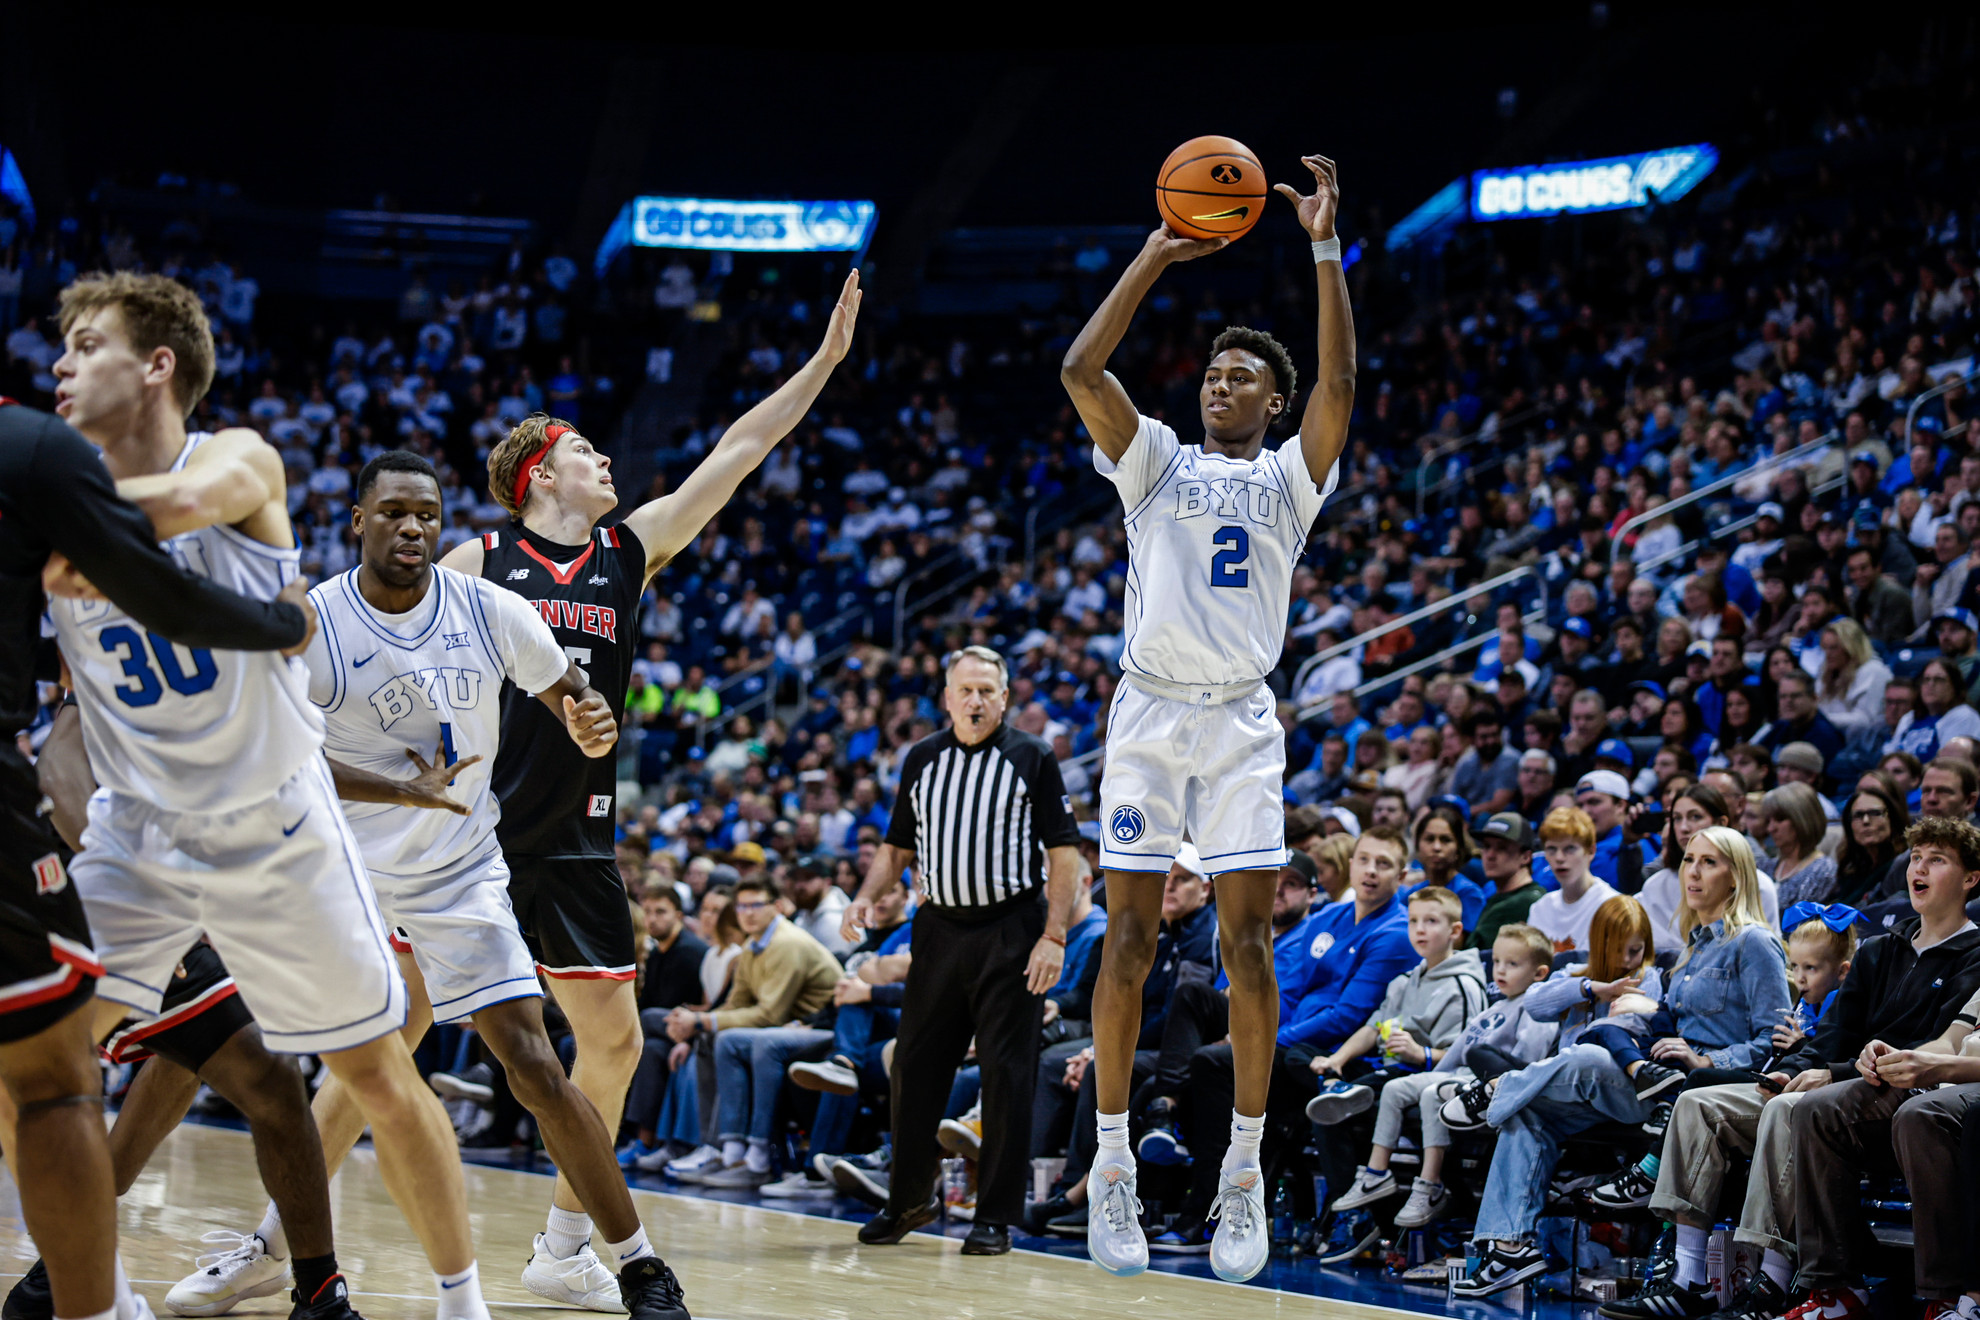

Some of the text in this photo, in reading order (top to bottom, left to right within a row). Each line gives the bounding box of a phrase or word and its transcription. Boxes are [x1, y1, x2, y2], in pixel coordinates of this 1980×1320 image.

[1479, 163, 1634, 214] GO COUGS
[646, 207, 684, 236] GO
[1174, 478, 1282, 528] BYU
[1210, 525, 1250, 588] 2
[530, 599, 617, 645] NVER
[99, 624, 219, 708] 30
[368, 666, 482, 732] BYU
[594, 798, 606, 811] XL
[1119, 827, 1132, 838] Y
[31, 851, 68, 896] D
